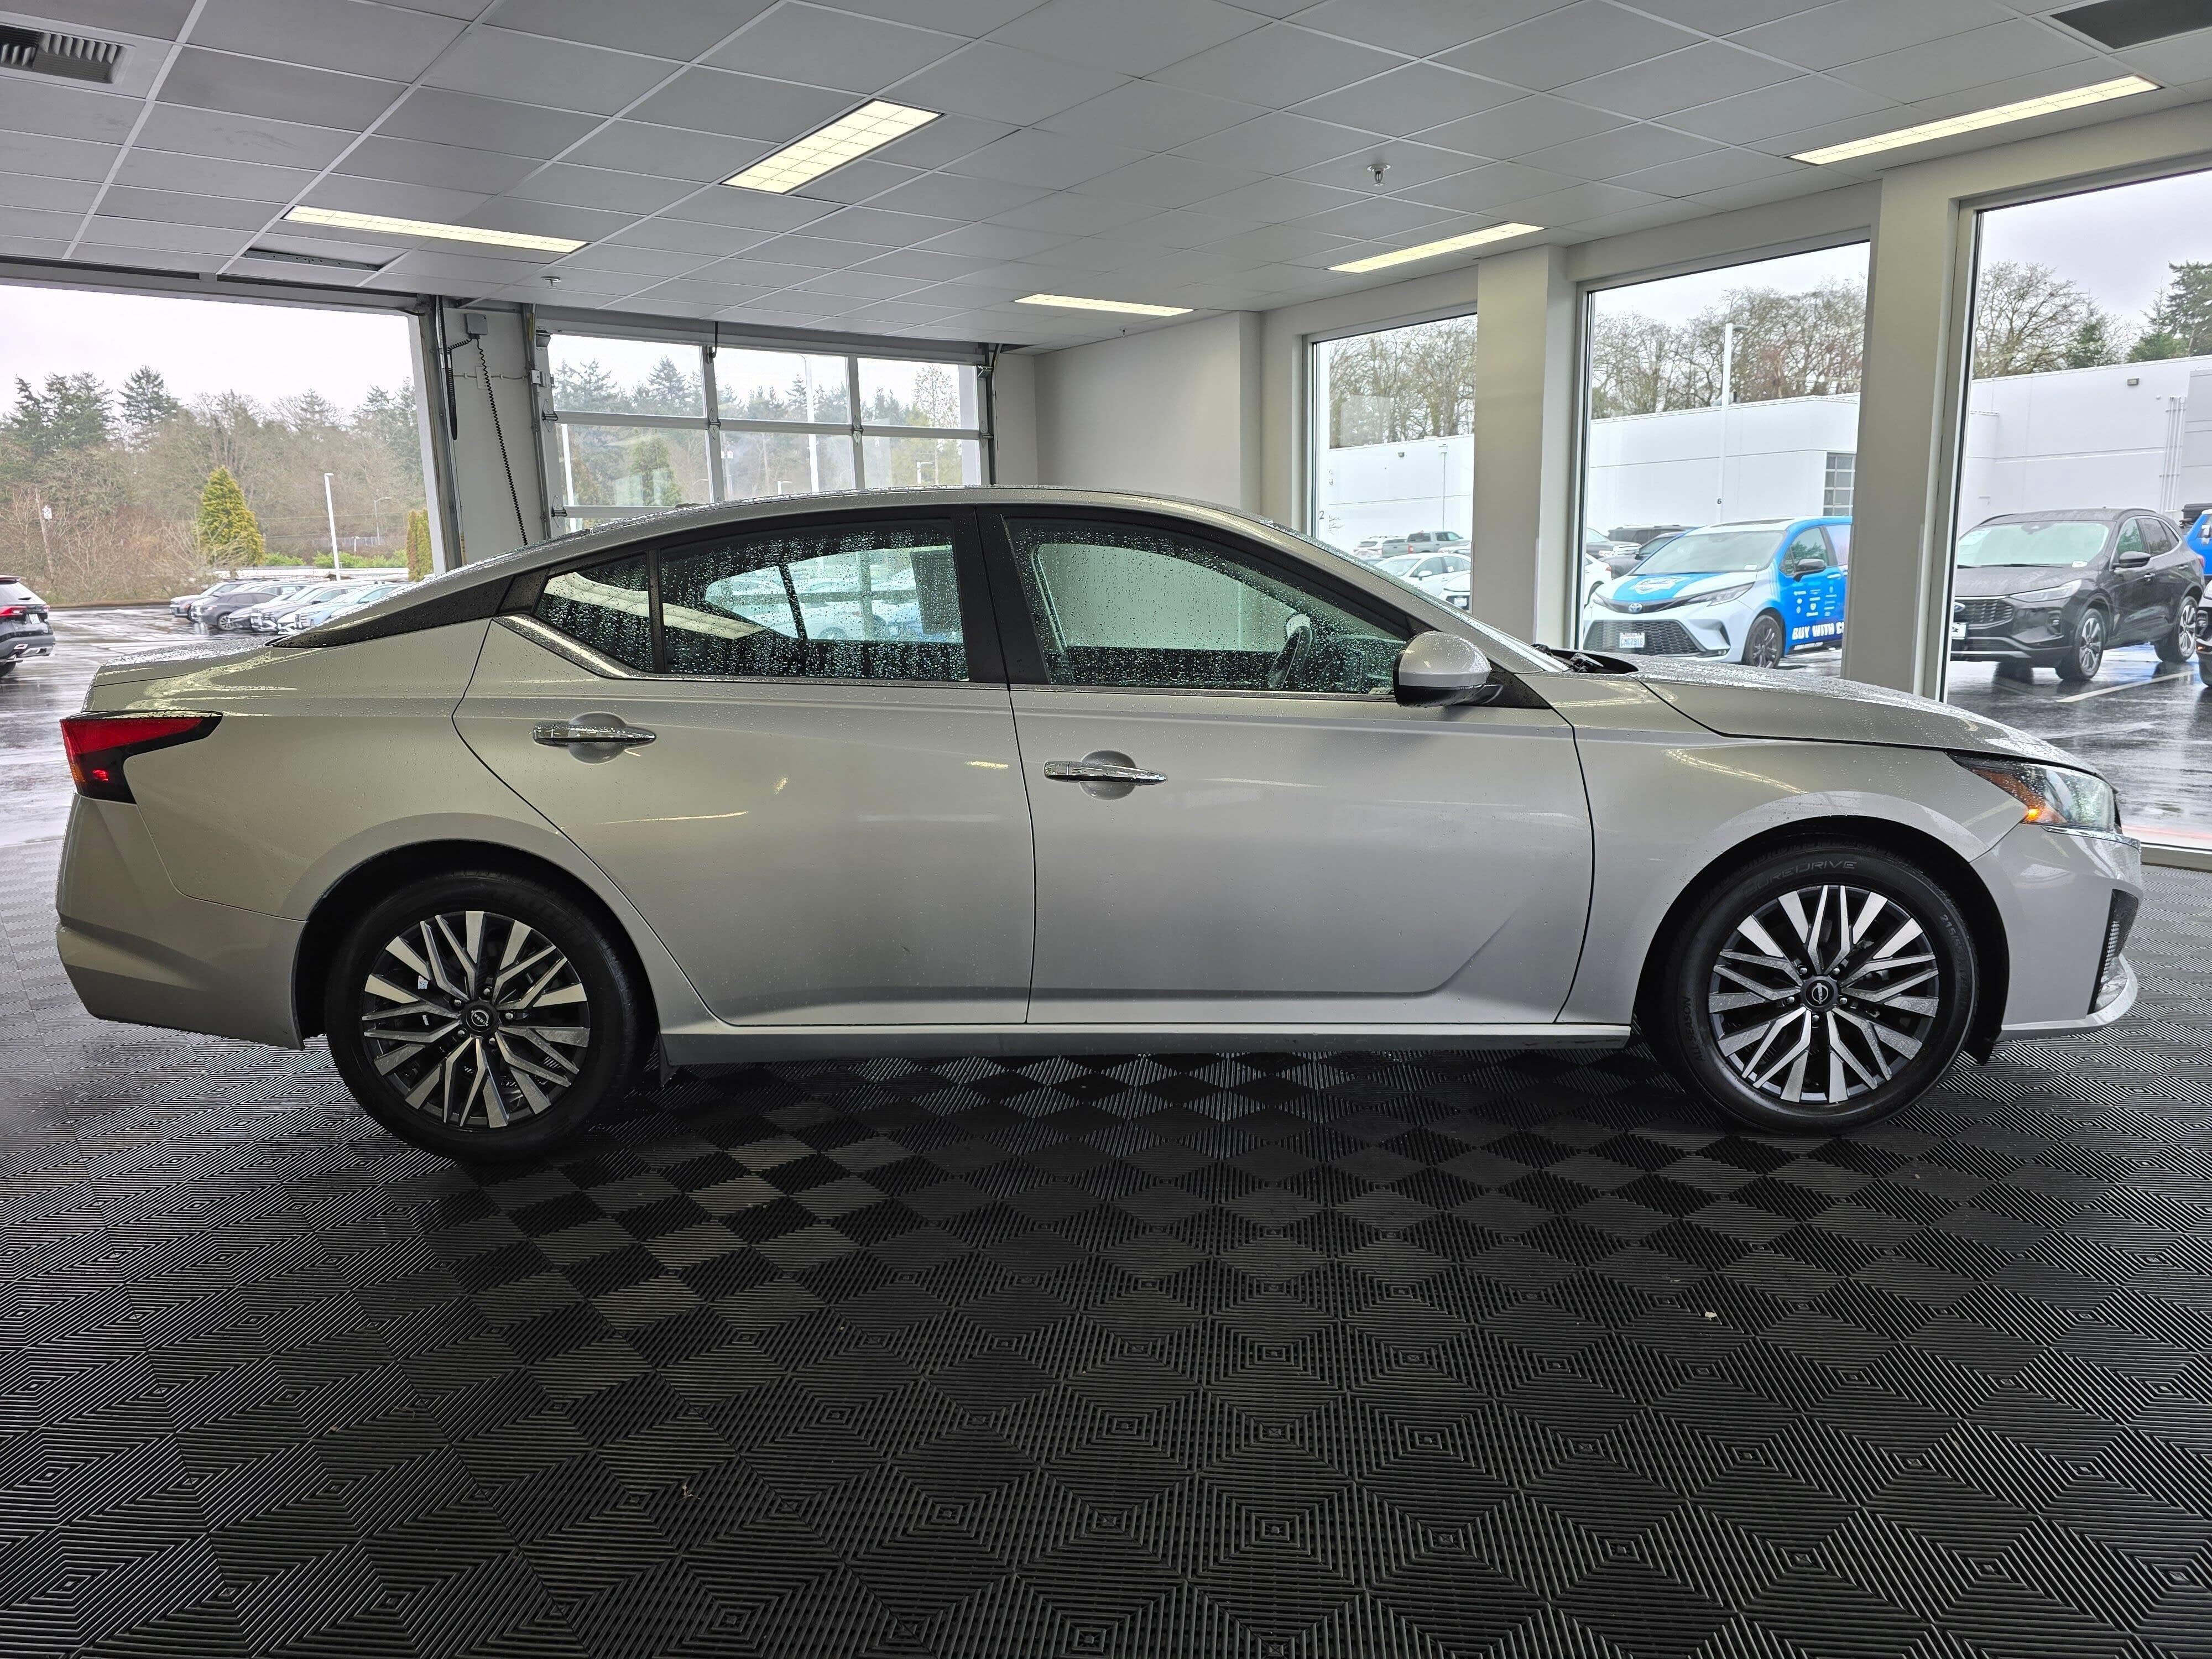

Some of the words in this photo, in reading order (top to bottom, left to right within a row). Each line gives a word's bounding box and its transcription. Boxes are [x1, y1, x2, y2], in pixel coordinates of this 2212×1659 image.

[1792, 626, 1810, 640] BUY
[1812, 623, 1835, 637] WITH
[471, 1010, 489, 1027] NISSAN
